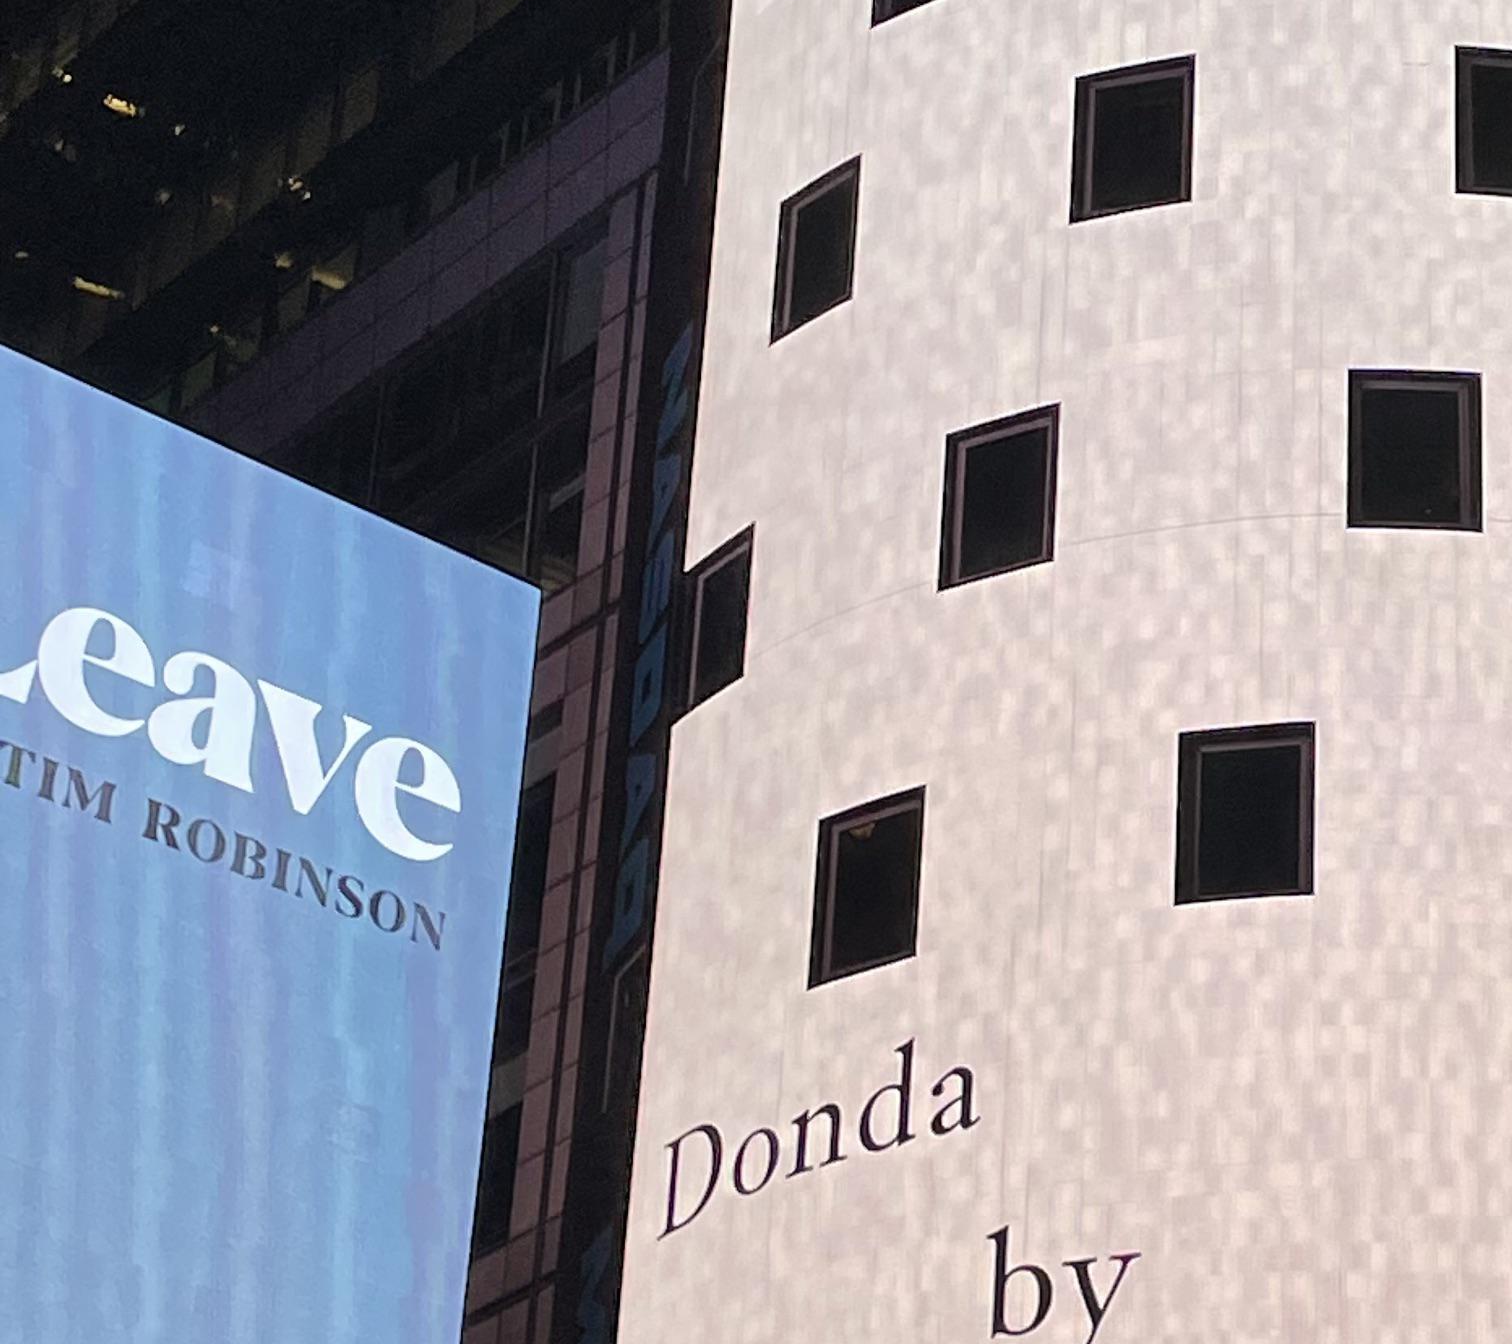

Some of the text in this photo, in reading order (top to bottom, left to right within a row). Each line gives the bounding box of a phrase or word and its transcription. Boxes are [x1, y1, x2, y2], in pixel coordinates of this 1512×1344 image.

[0, 607, 461, 861] eave
[0, 740, 447, 951] TIM ROBINSON
[657, 1037, 981, 1241] Donda
